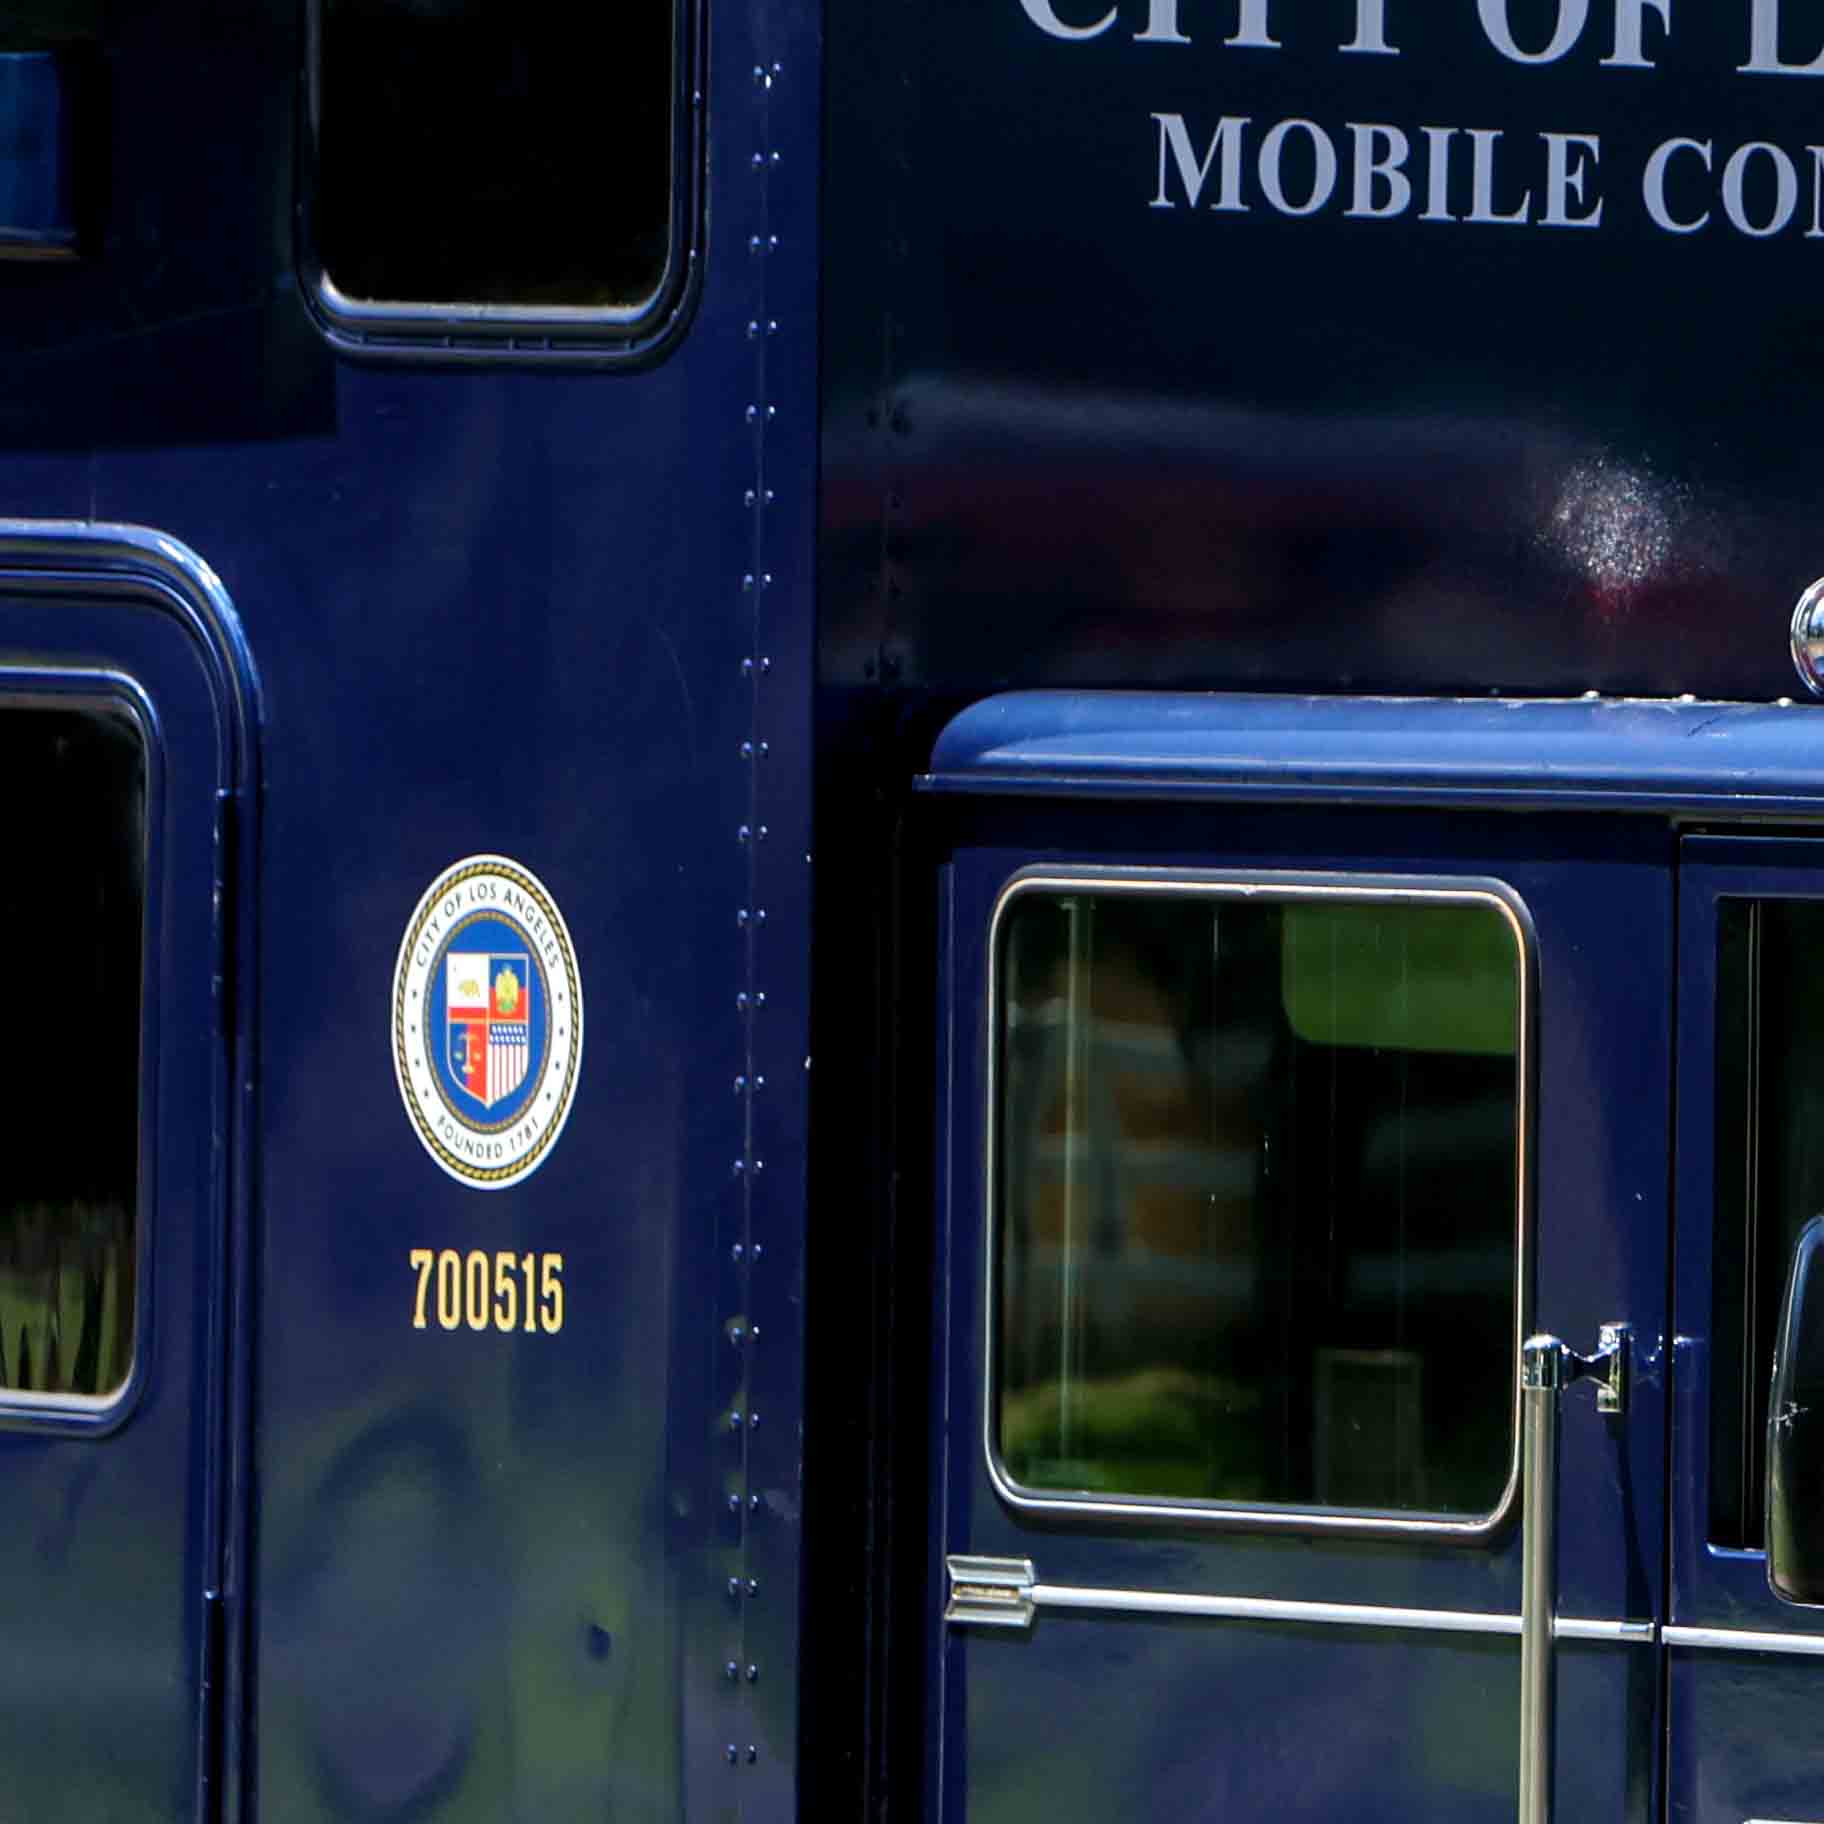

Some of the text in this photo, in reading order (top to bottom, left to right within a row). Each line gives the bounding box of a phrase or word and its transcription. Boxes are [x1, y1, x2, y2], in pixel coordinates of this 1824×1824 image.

[1148, 112, 1603, 227] MOBILE
[416, 883, 560, 969] CITY OF LOS ANGELES
[437, 1115, 539, 1159] FOUNDED 1781
[409, 1248, 565, 1335] 700515
